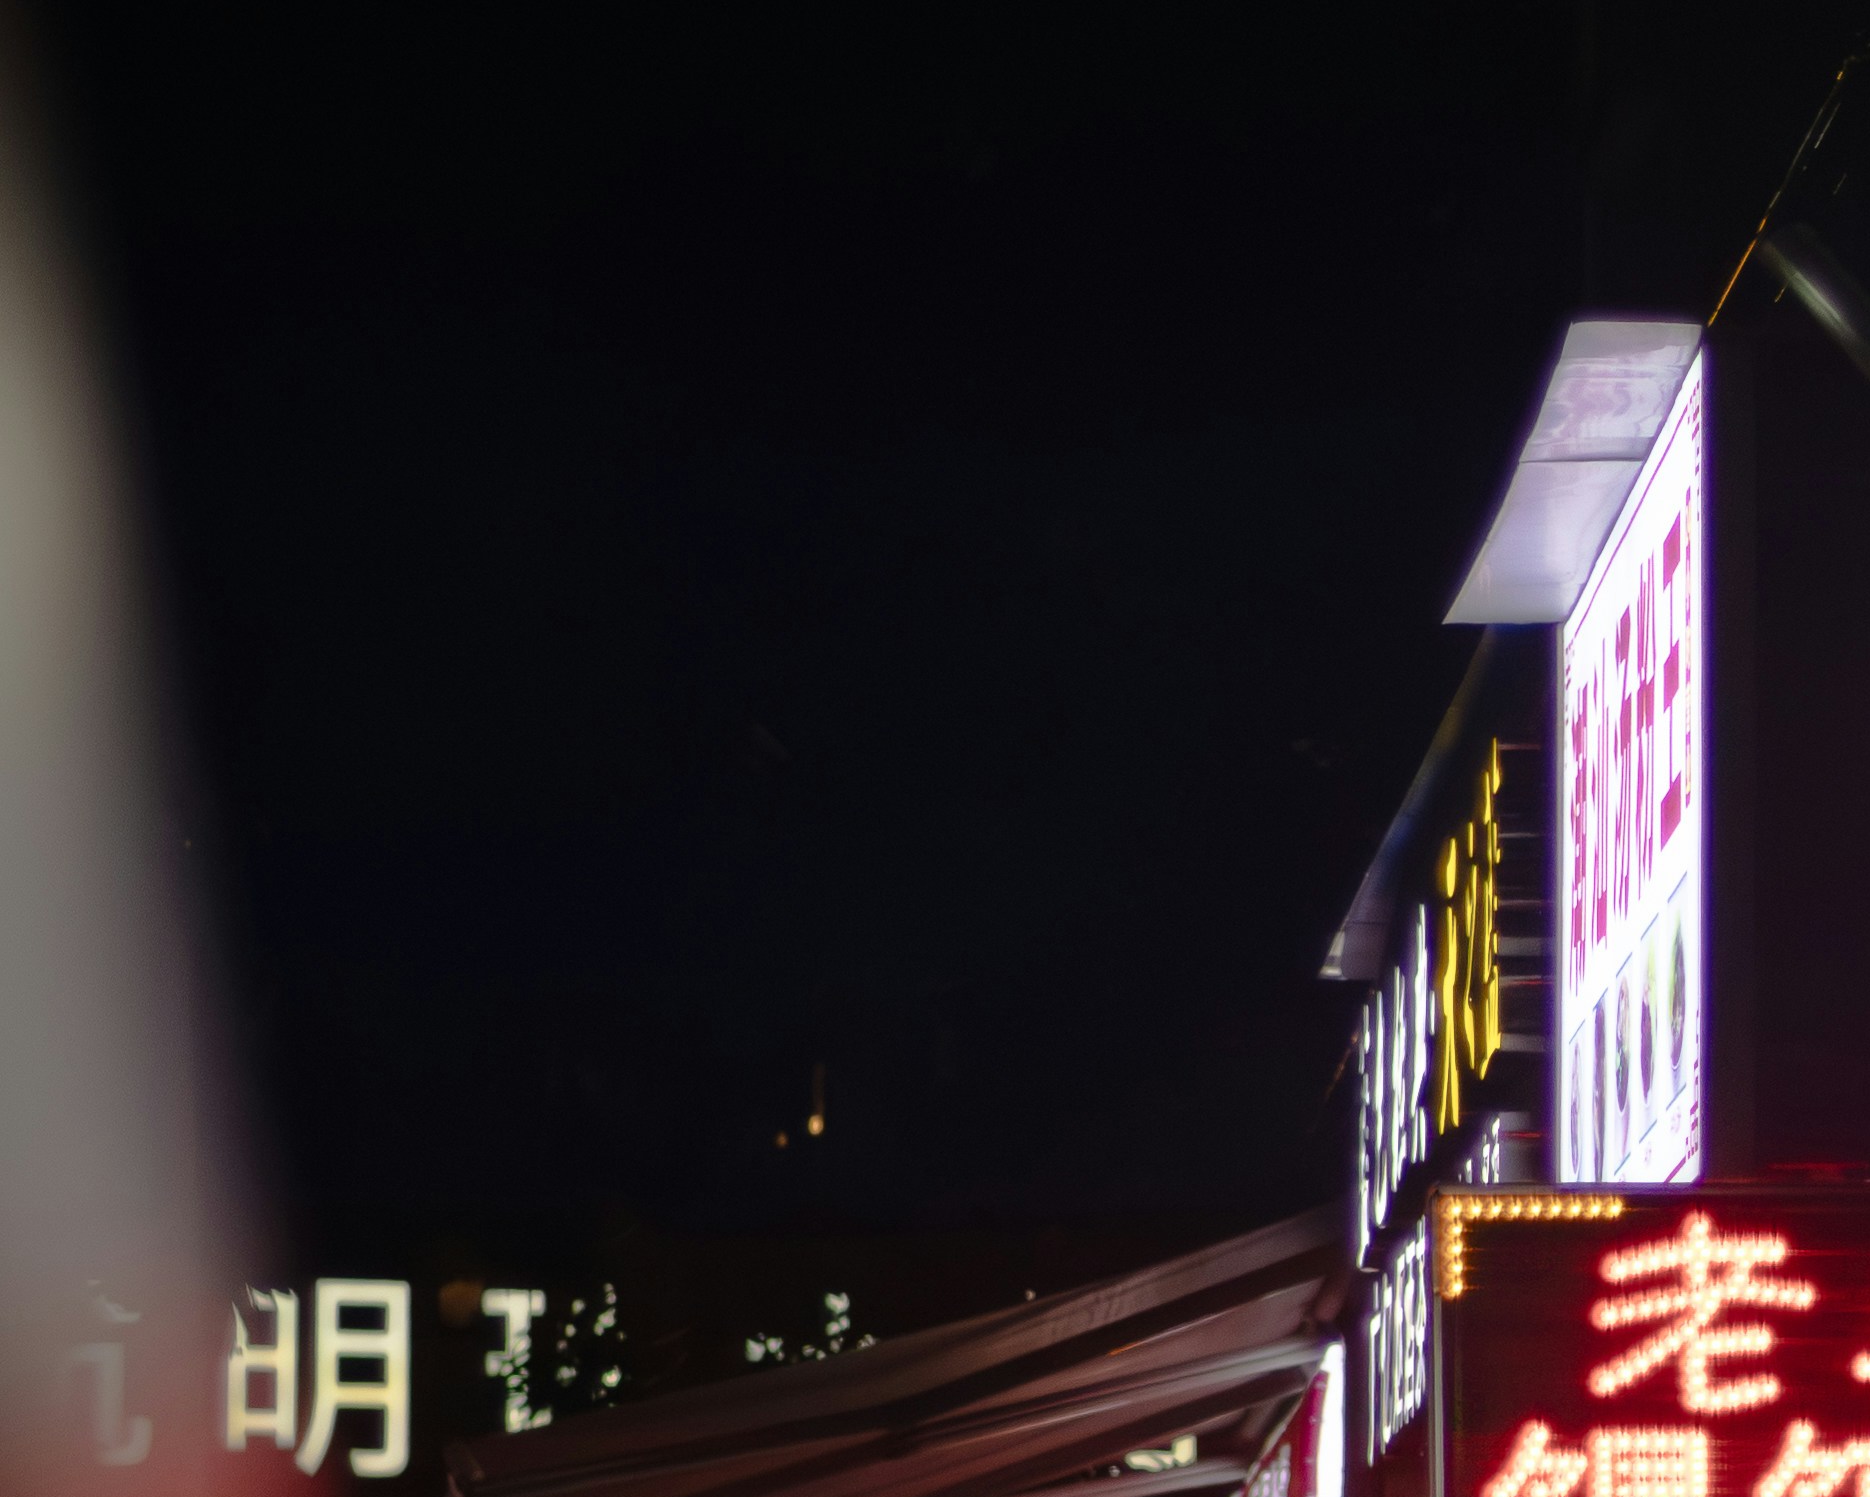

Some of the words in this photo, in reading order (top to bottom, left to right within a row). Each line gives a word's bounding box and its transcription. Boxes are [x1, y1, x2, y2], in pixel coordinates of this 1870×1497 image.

[1568, 509, 1683, 996] 潮汕汤粉王
